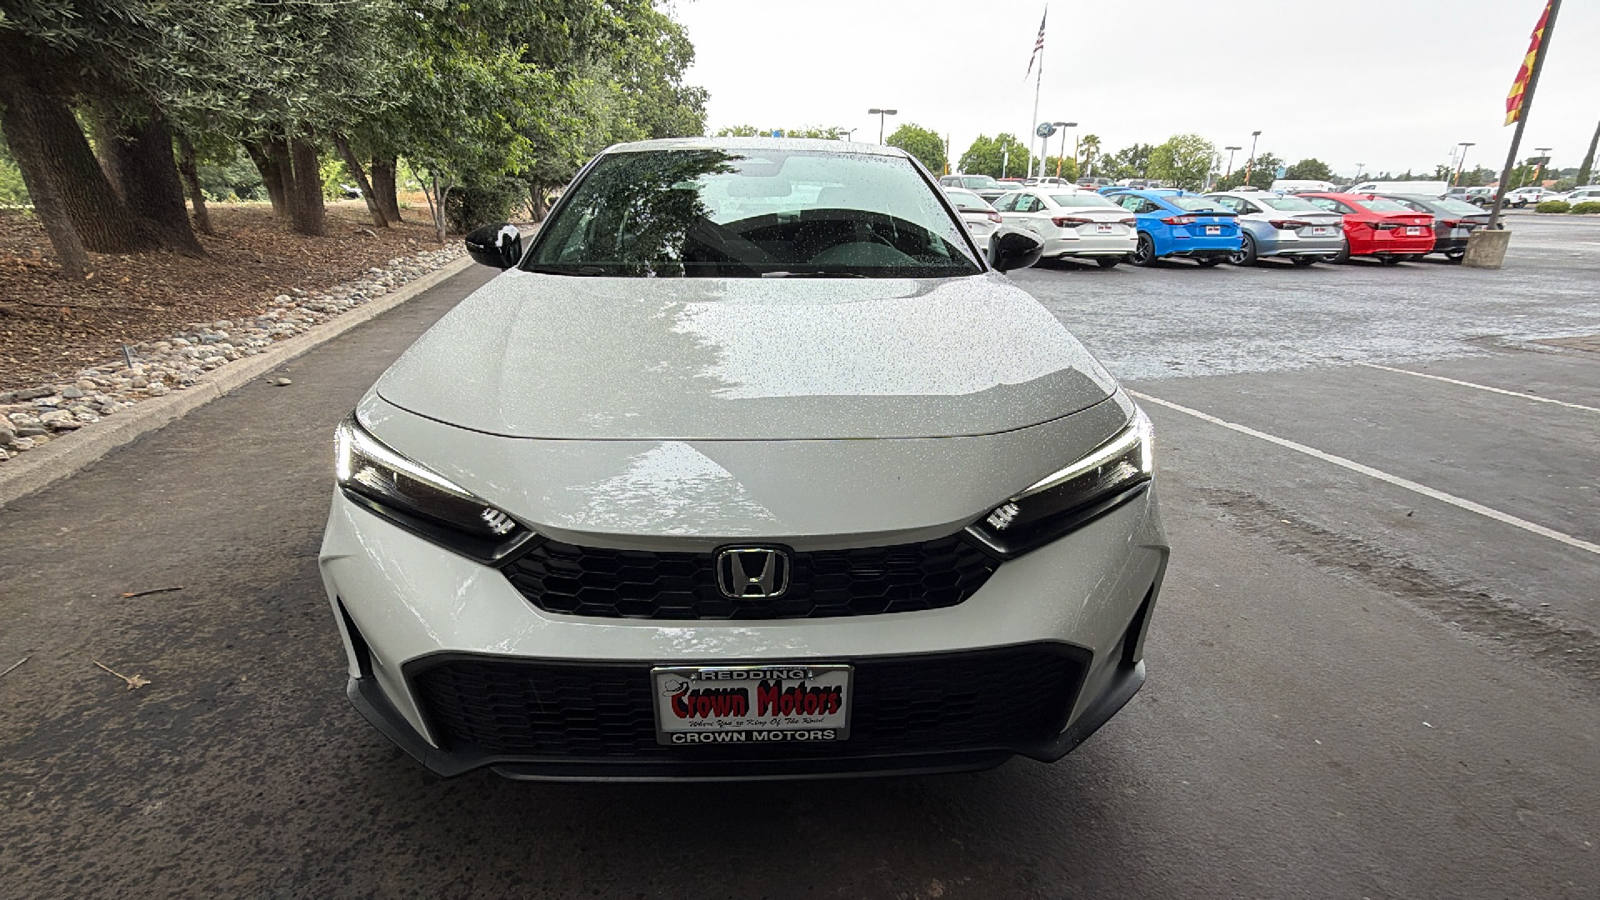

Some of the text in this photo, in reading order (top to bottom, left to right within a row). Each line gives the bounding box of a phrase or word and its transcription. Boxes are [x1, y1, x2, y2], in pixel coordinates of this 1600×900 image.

[701, 670, 805, 680] REDDING
[671, 680, 842, 719] Crown Motors
[746, 719, 767, 727] King
[770, 718, 781, 726] Of
[784, 717, 799, 725] The
[672, 730, 836, 744] CROWN MOTORS
